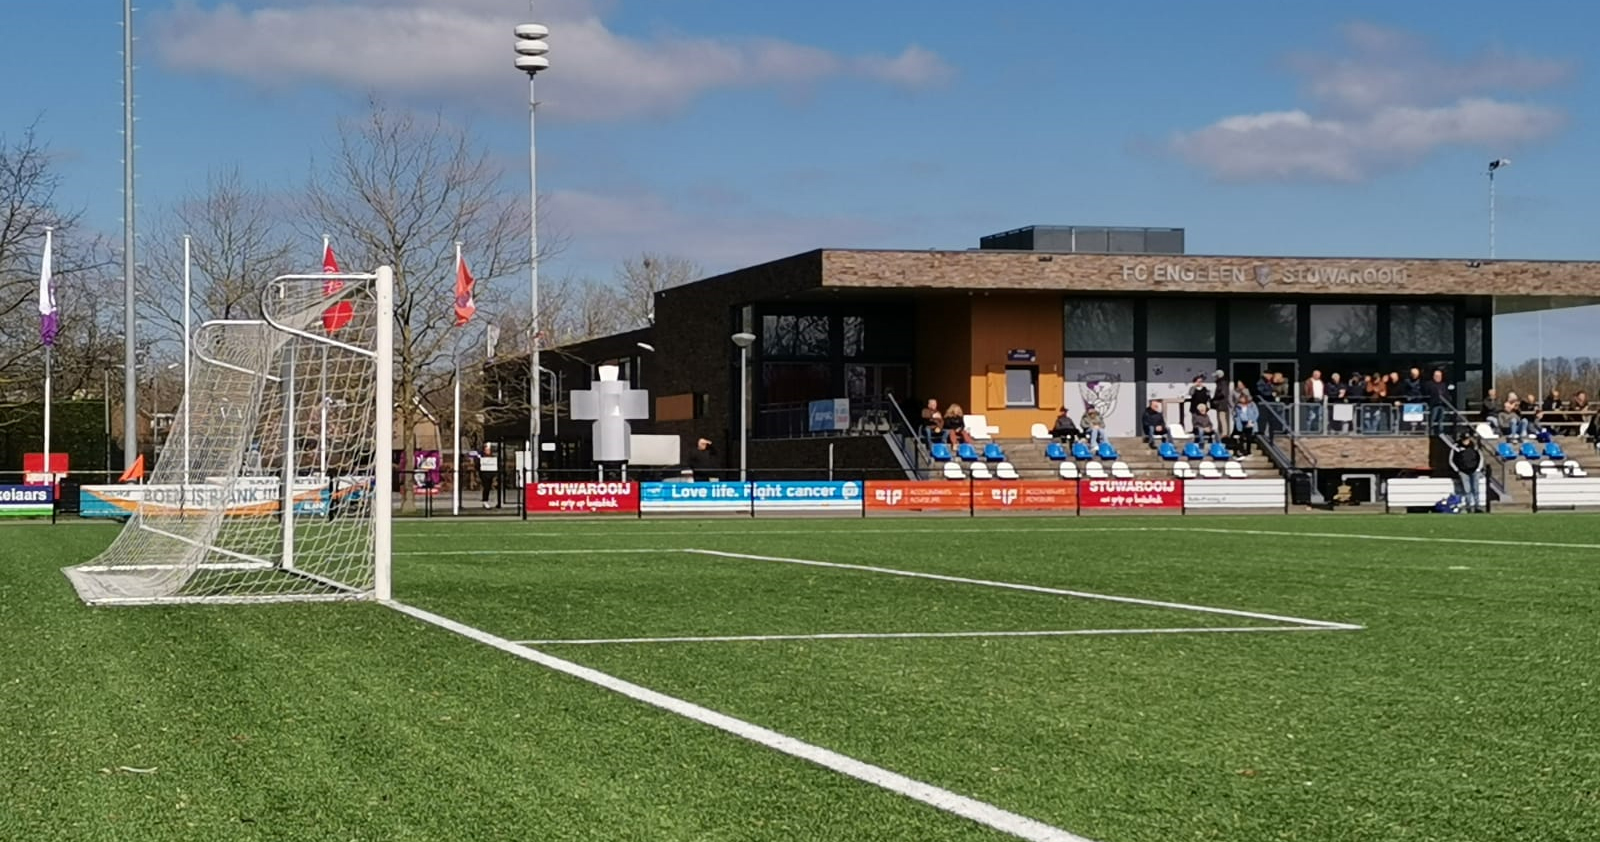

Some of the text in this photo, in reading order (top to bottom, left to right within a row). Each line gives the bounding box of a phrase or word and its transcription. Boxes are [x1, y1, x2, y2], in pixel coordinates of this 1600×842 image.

[1122, 264, 1408, 284] FC ENGELEN STUWAROOIJ
[536, 482, 631, 495] STUWAROOIJ
[671, 484, 707, 498] Love
[711, 484, 740, 498] life.
[743, 482, 782, 499] Fight
[786, 486, 836, 498] cancer
[1089, 480, 1175, 493] STUWAROOIJ
